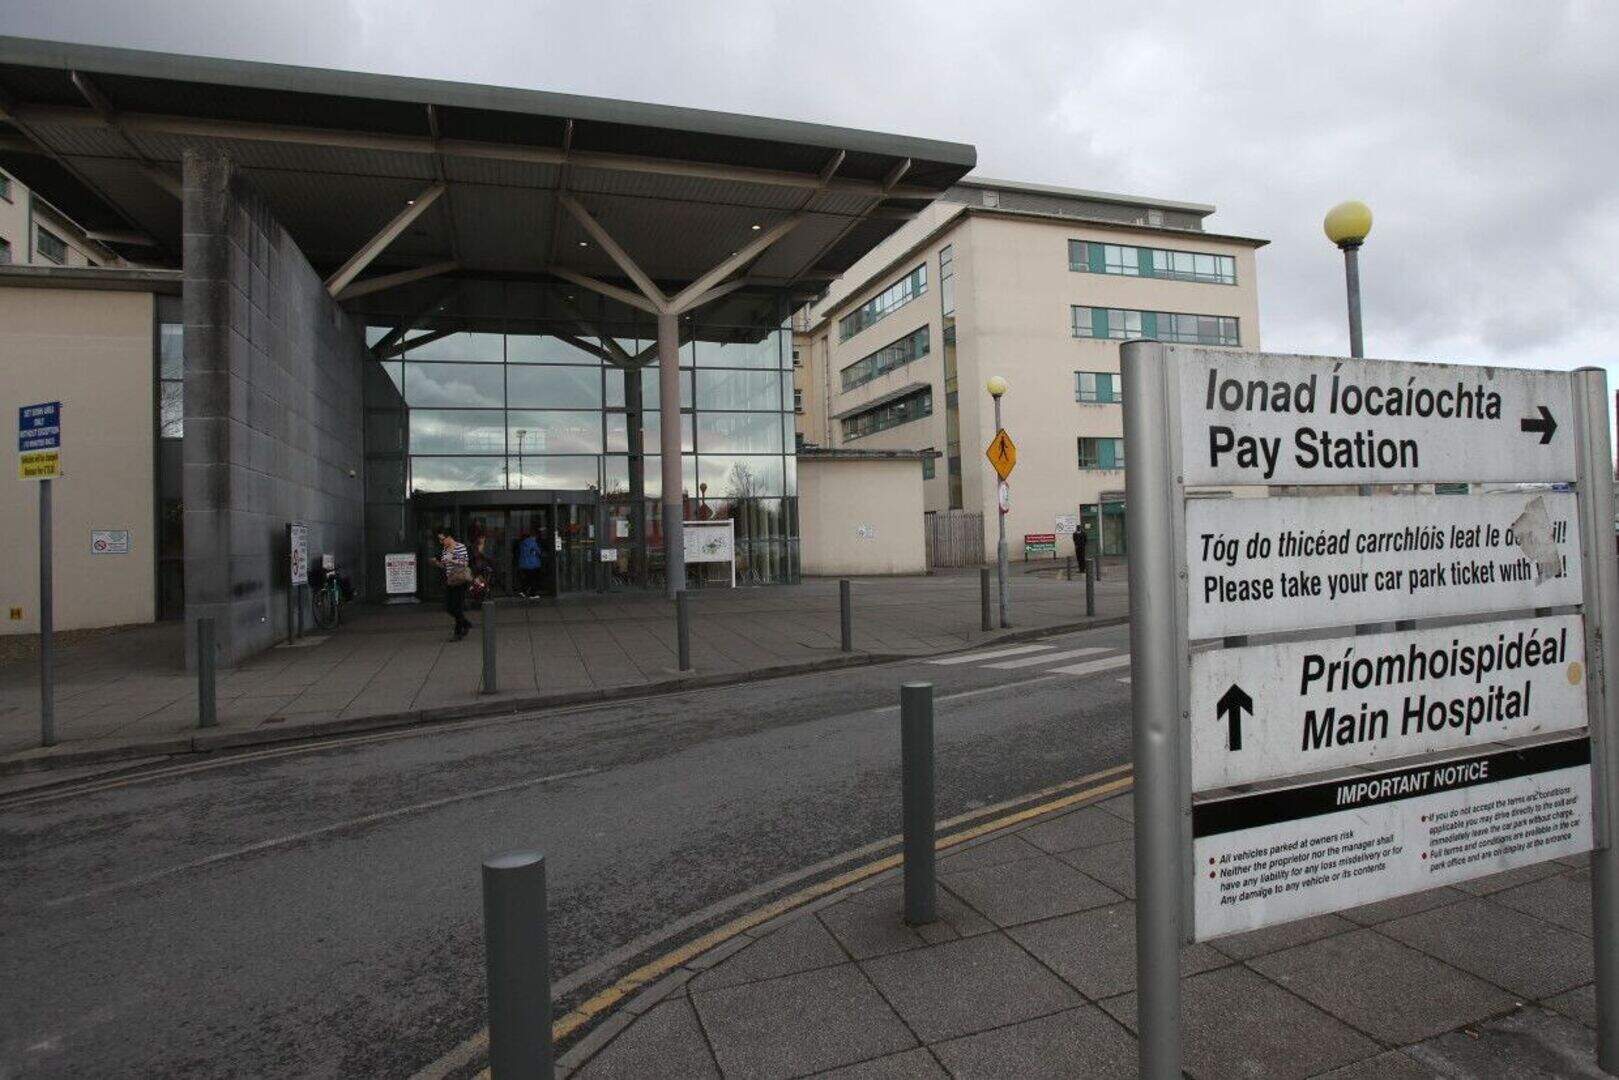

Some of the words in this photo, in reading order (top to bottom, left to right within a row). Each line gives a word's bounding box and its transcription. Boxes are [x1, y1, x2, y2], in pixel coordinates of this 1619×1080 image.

[1206, 368, 1317, 413] Ionad
[1330, 362, 1502, 420] Íocaíochta
[1209, 425, 1281, 479] Pay
[1295, 426, 1419, 469] Station
[1201, 533, 1239, 567] Tóg
[1246, 532, 1271, 559] do
[1278, 529, 1350, 557] thicéad
[1356, 525, 1445, 554] carrchlóis
[1450, 525, 1481, 549] leat
[1485, 523, 1500, 547] le
[1204, 575, 1274, 604] Please
[1280, 570, 1321, 598] take
[1328, 571, 1368, 600] your
[1375, 569, 1403, 591] car
[1409, 562, 1446, 595] park
[1450, 560, 1495, 586] ticket
[1499, 557, 1531, 582] with
[1300, 628, 1567, 695] Príomhoispidéal
[1301, 703, 1389, 752] Main
[1401, 680, 1531, 736] Hospital
[1336, 771, 1430, 806] IMPORTANT
[1433, 761, 1489, 788] NOTICE
[1429, 820, 1464, 835] applicable
[1465, 818, 1478, 828] you
[1479, 814, 1493, 823] may
[1494, 811, 1510, 821] drive
[1511, 805, 1534, 817] directly
[1535, 804, 1542, 812] to
[1543, 801, 1553, 810] the
[1429, 831, 1470, 847] immediately
[1471, 827, 1489, 837] leave
[1489, 825, 1501, 833] the
[1502, 822, 1512, 831] car
[1513, 819, 1527, 829] park
[1528, 813, 1551, 825] without
[1436, 812, 1448, 821] you
[1449, 809, 1458, 818] do
[1460, 806, 1471, 815] not
[1472, 802, 1495, 813] accept
[1219, 853, 1231, 864] All
[1233, 847, 1268, 861] vehicles
[1270, 841, 1298, 855] parked
[1300, 839, 1308, 849] at
[1309, 833, 1339, 846] owners
[1340, 829, 1353, 841] risk
[1220, 864, 1252, 878] Neither
[1253, 861, 1267, 871] the
[1269, 852, 1310, 870] proprietor
[1311, 849, 1326, 860] nor
[1327, 845, 1340, 856] the
[1341, 839, 1375, 853] manager
[1376, 833, 1394, 846] shall
[1430, 861, 1445, 872] park
[1446, 857, 1466, 868] office
[1467, 853, 1480, 863] and
[1481, 850, 1492, 859] are
[1493, 849, 1502, 858] on
[1534, 838, 1544, 847] the
[1444, 846, 1463, 856] terms
[1464, 841, 1478, 851] and
[1478, 835, 1512, 848] conditions
[1513, 832, 1523, 840] are
[1559, 821, 1569, 830] the
[1220, 880, 1241, 892] have
[1242, 877, 1258, 888] any
[1260, 868, 1289, 883] liability
[1290, 867, 1303, 877] for
[1304, 864, 1319, 874] any
[1320, 860, 1337, 871] loss
[1338, 850, 1381, 866] misdelivery
[1382, 848, 1391, 858] or
[1392, 846, 1403, 856] for
[1220, 894, 1237, 906] Any
[1239, 886, 1273, 902] damage
[1274, 884, 1284, 894] to
[1285, 880, 1300, 891] any
[1301, 874, 1330, 887] vehicle
[1331, 872, 1341, 882] or
[1342, 868, 1351, 878] its
[1353, 861, 1386, 876] contents
